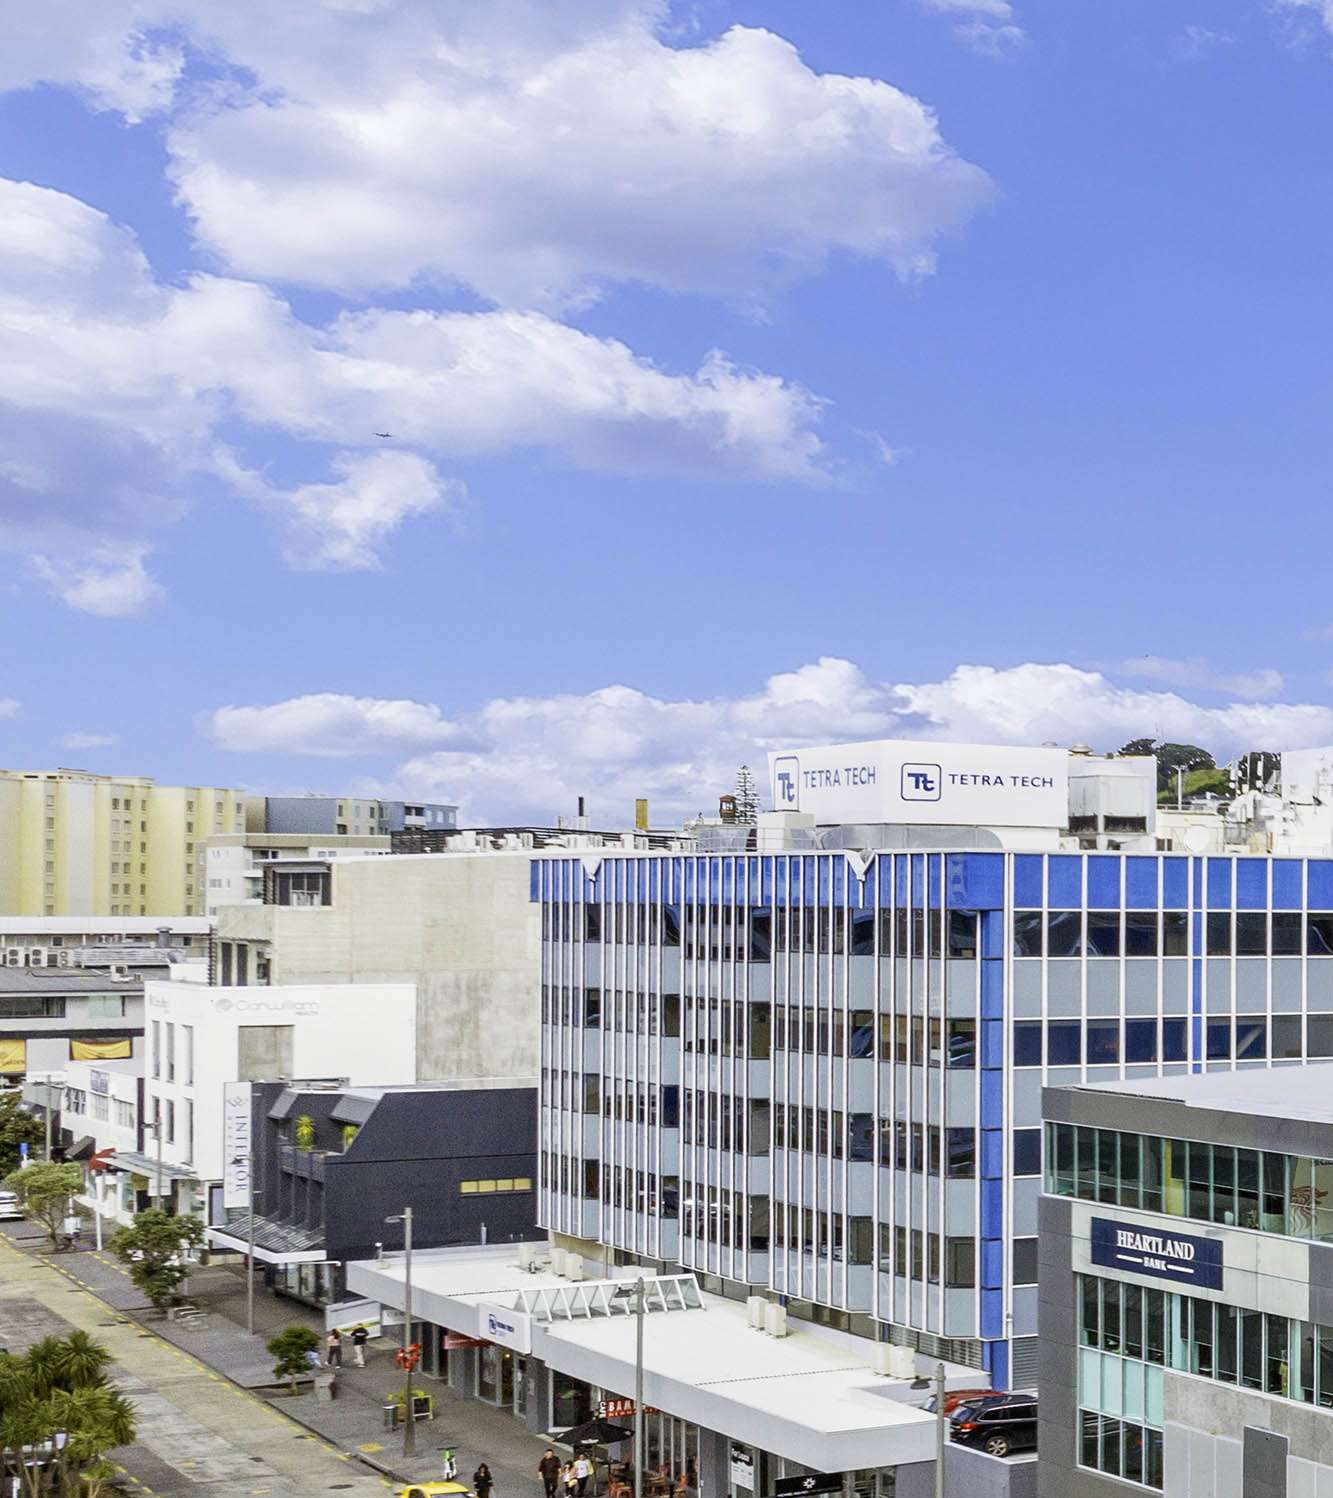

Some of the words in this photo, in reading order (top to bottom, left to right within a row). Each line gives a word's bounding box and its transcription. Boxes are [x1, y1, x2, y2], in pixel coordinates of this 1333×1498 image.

[803, 768, 840, 788] TETRA
[844, 766, 876, 785] TECH
[949, 773, 1004, 787] TETRA
[1010, 776, 1053, 788] TECH
[1116, 1229, 1195, 1260] HEARTLAND
[1143, 1256, 1167, 1271] BANK
